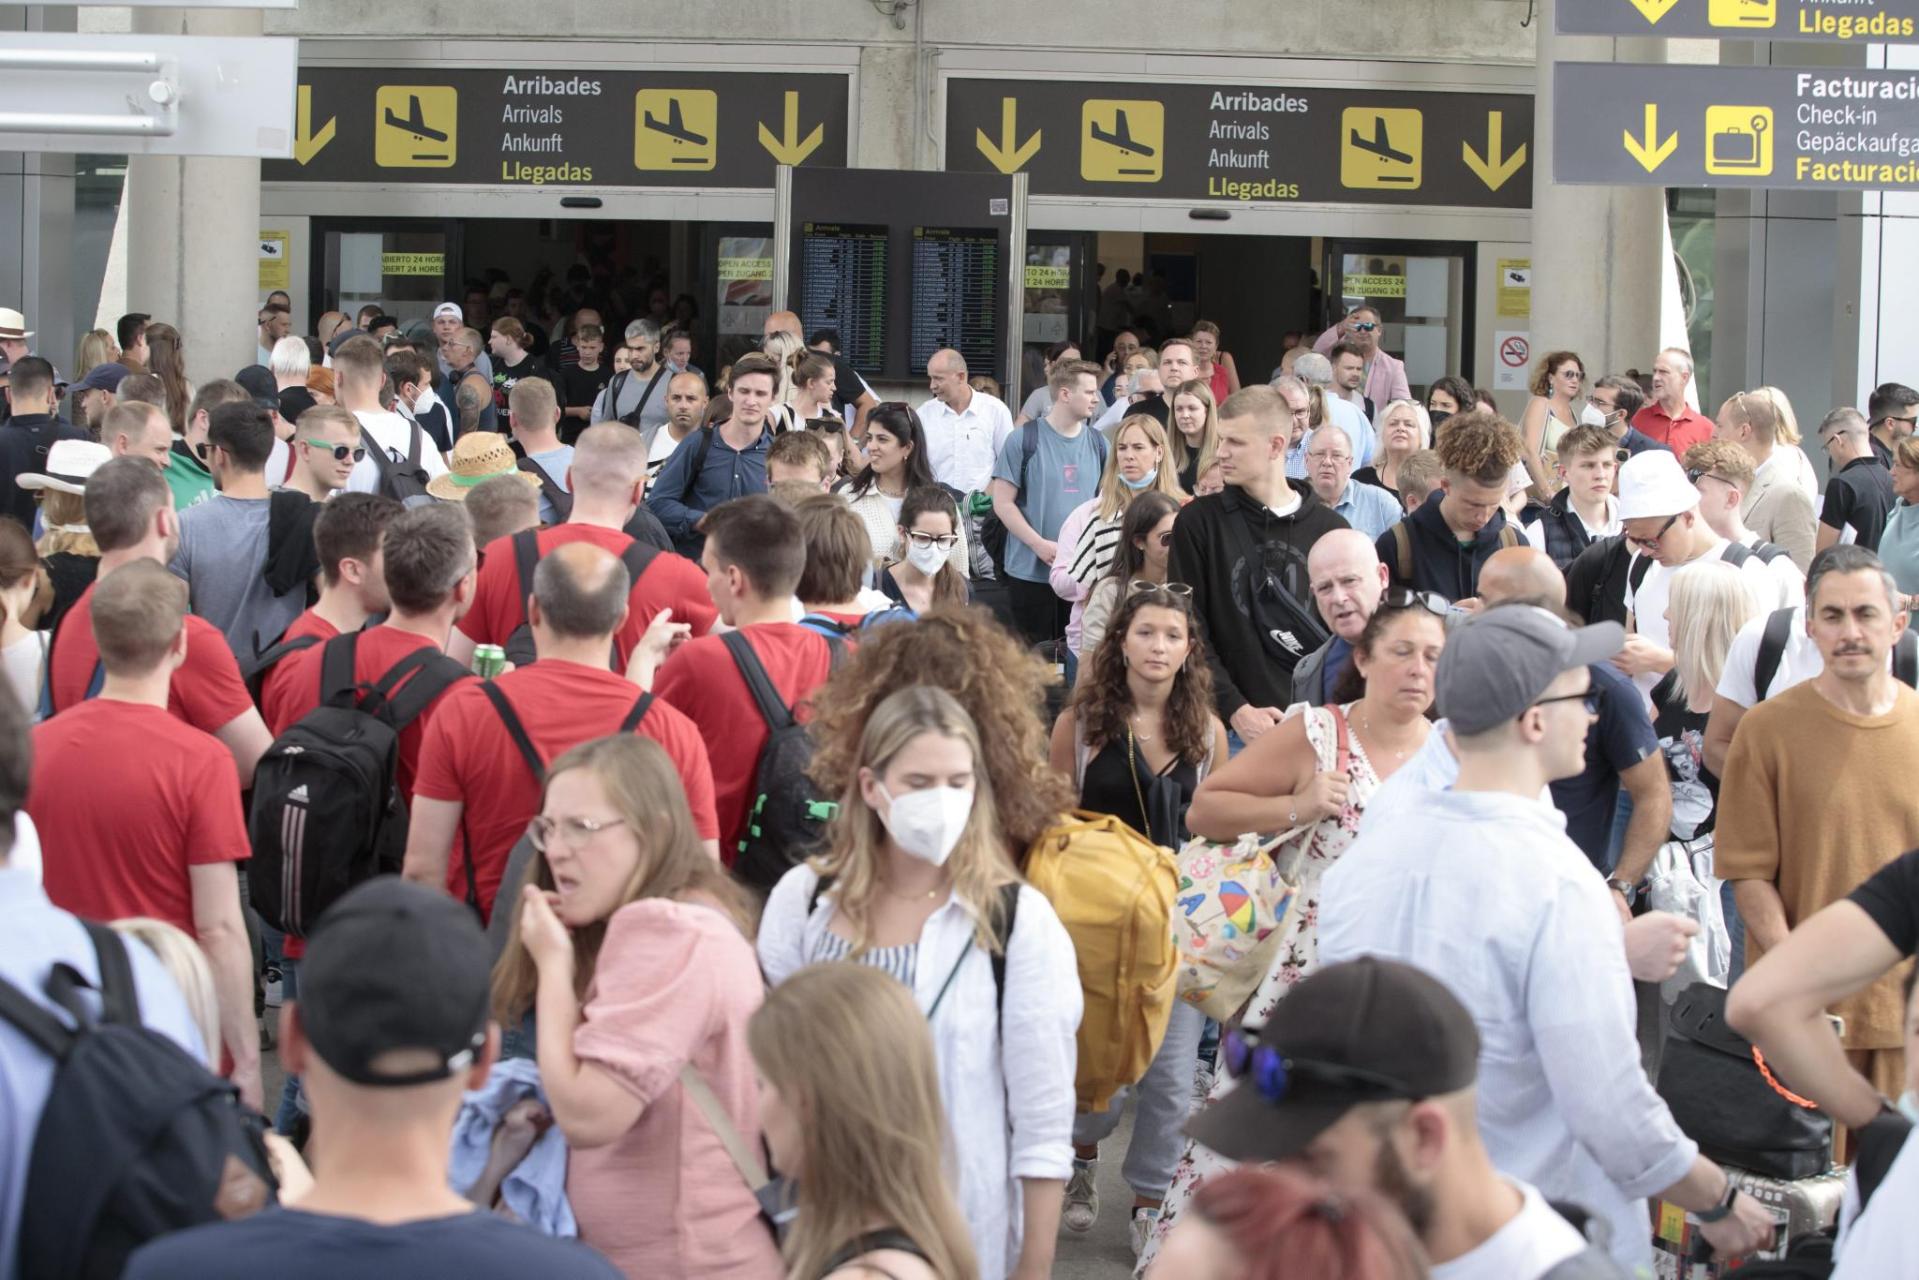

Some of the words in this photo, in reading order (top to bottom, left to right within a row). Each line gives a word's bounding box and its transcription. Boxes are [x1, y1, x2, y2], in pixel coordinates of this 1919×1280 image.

[1799, 8, 1914, 39] Llegadas
[502, 75, 602, 96] Arribades
[1797, 73, 1919, 100] Facturaci
[1209, 91, 1309, 113] Arribades
[502, 103, 563, 124] Arrivals
[1796, 103, 1877, 126] Check-in
[1208, 119, 1270, 141] Arrivals
[501, 132, 563, 153] Ankunft
[1796, 130, 1919, 157] Gepäckaufga
[1208, 148, 1270, 169] Ankunft
[502, 160, 593, 185] Llegadas
[1796, 157, 1919, 183] Facturaci
[1208, 176, 1300, 201] Llegadas
[407, 265, 417, 273] 24
[413, 255, 423, 263] 24
